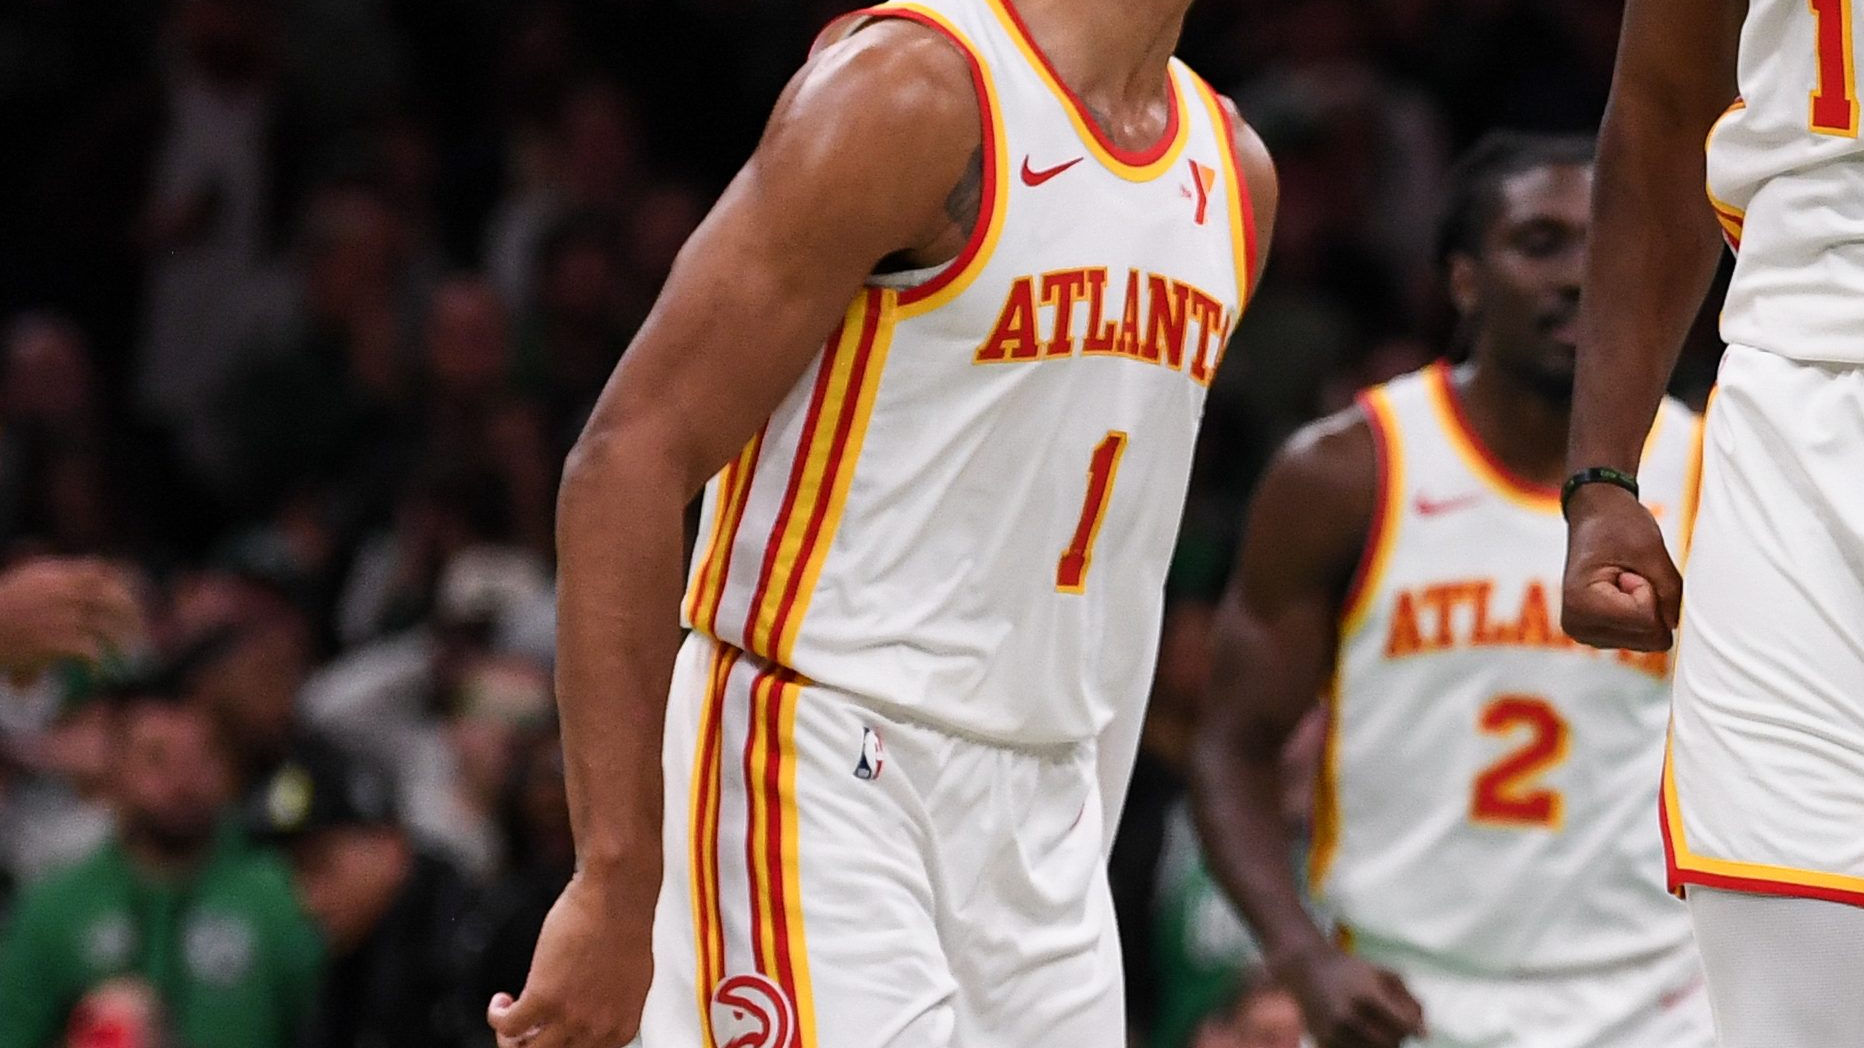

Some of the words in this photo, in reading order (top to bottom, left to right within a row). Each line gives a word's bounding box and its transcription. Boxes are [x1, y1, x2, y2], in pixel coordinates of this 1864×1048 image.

[972, 265, 1232, 387] ATLANT
[1054, 430, 1128, 595] 1
[1383, 577, 1670, 680] ATLA
[1470, 695, 1572, 829] 2
